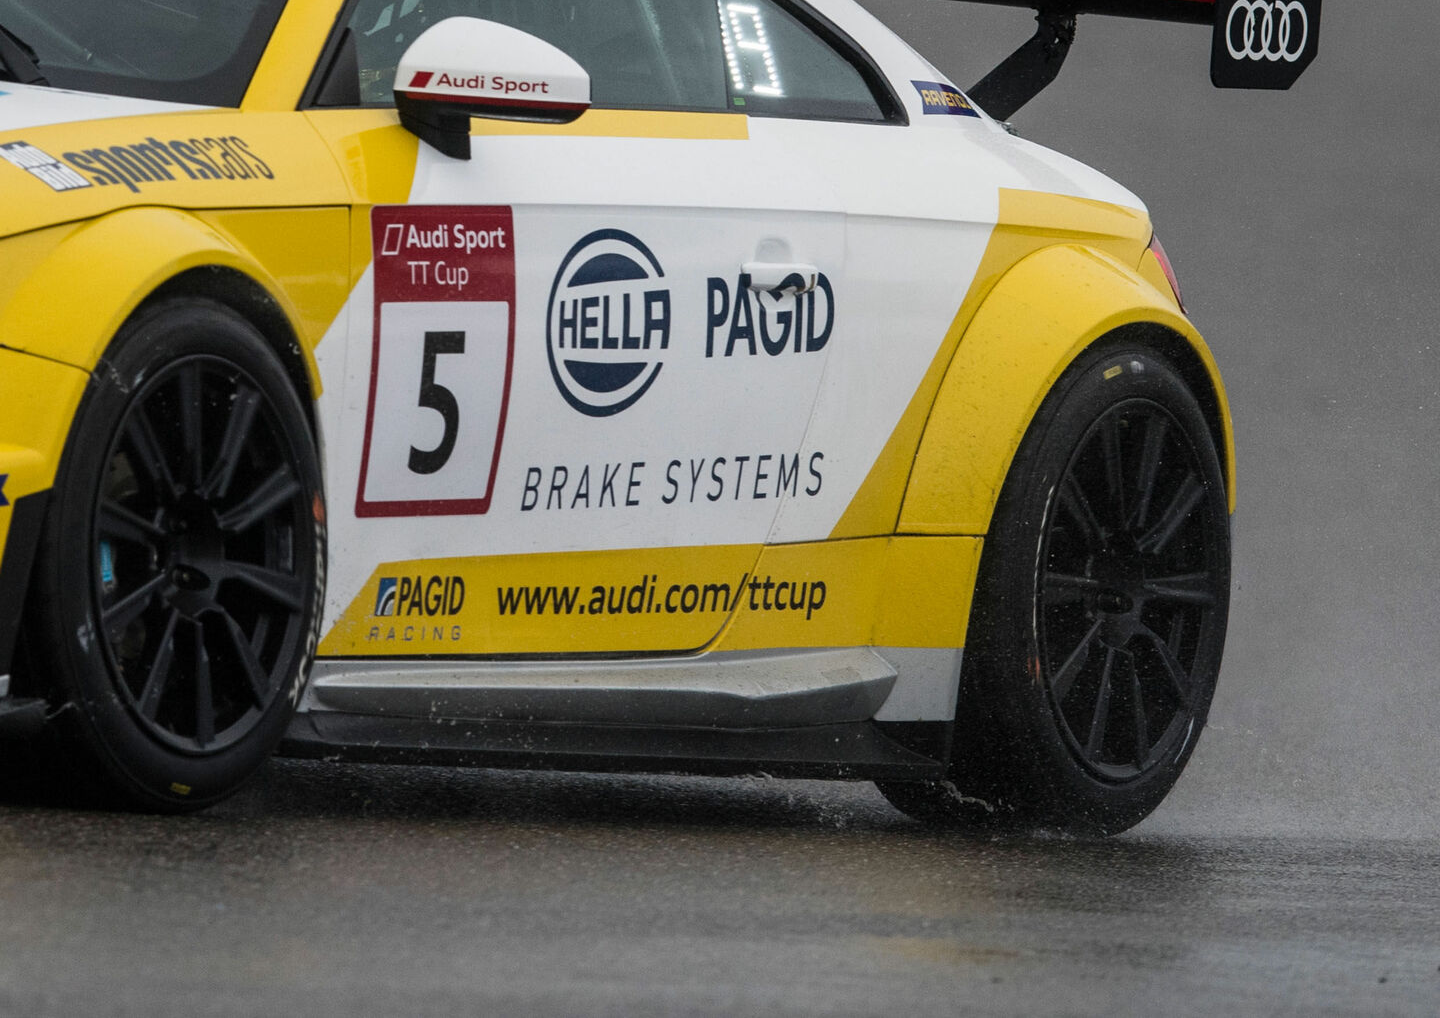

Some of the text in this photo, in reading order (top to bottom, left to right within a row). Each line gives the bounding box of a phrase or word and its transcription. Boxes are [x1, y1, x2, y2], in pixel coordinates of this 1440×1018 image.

[437, 73, 549, 94] Audi Sport
[62, 135, 275, 194] sportscars
[406, 224, 507, 254] Audi Sport
[407, 260, 470, 291] TT Cup
[558, 288, 671, 351] HELLA
[705, 272, 835, 358] PAGID
[406, 330, 466, 475] 5
[520, 451, 826, 512] BRAKE SYSTEMS
[396, 575, 465, 617] PAGID
[496, 572, 827, 621] www.audi.com/ttcup
[368, 625, 462, 642] RACING
